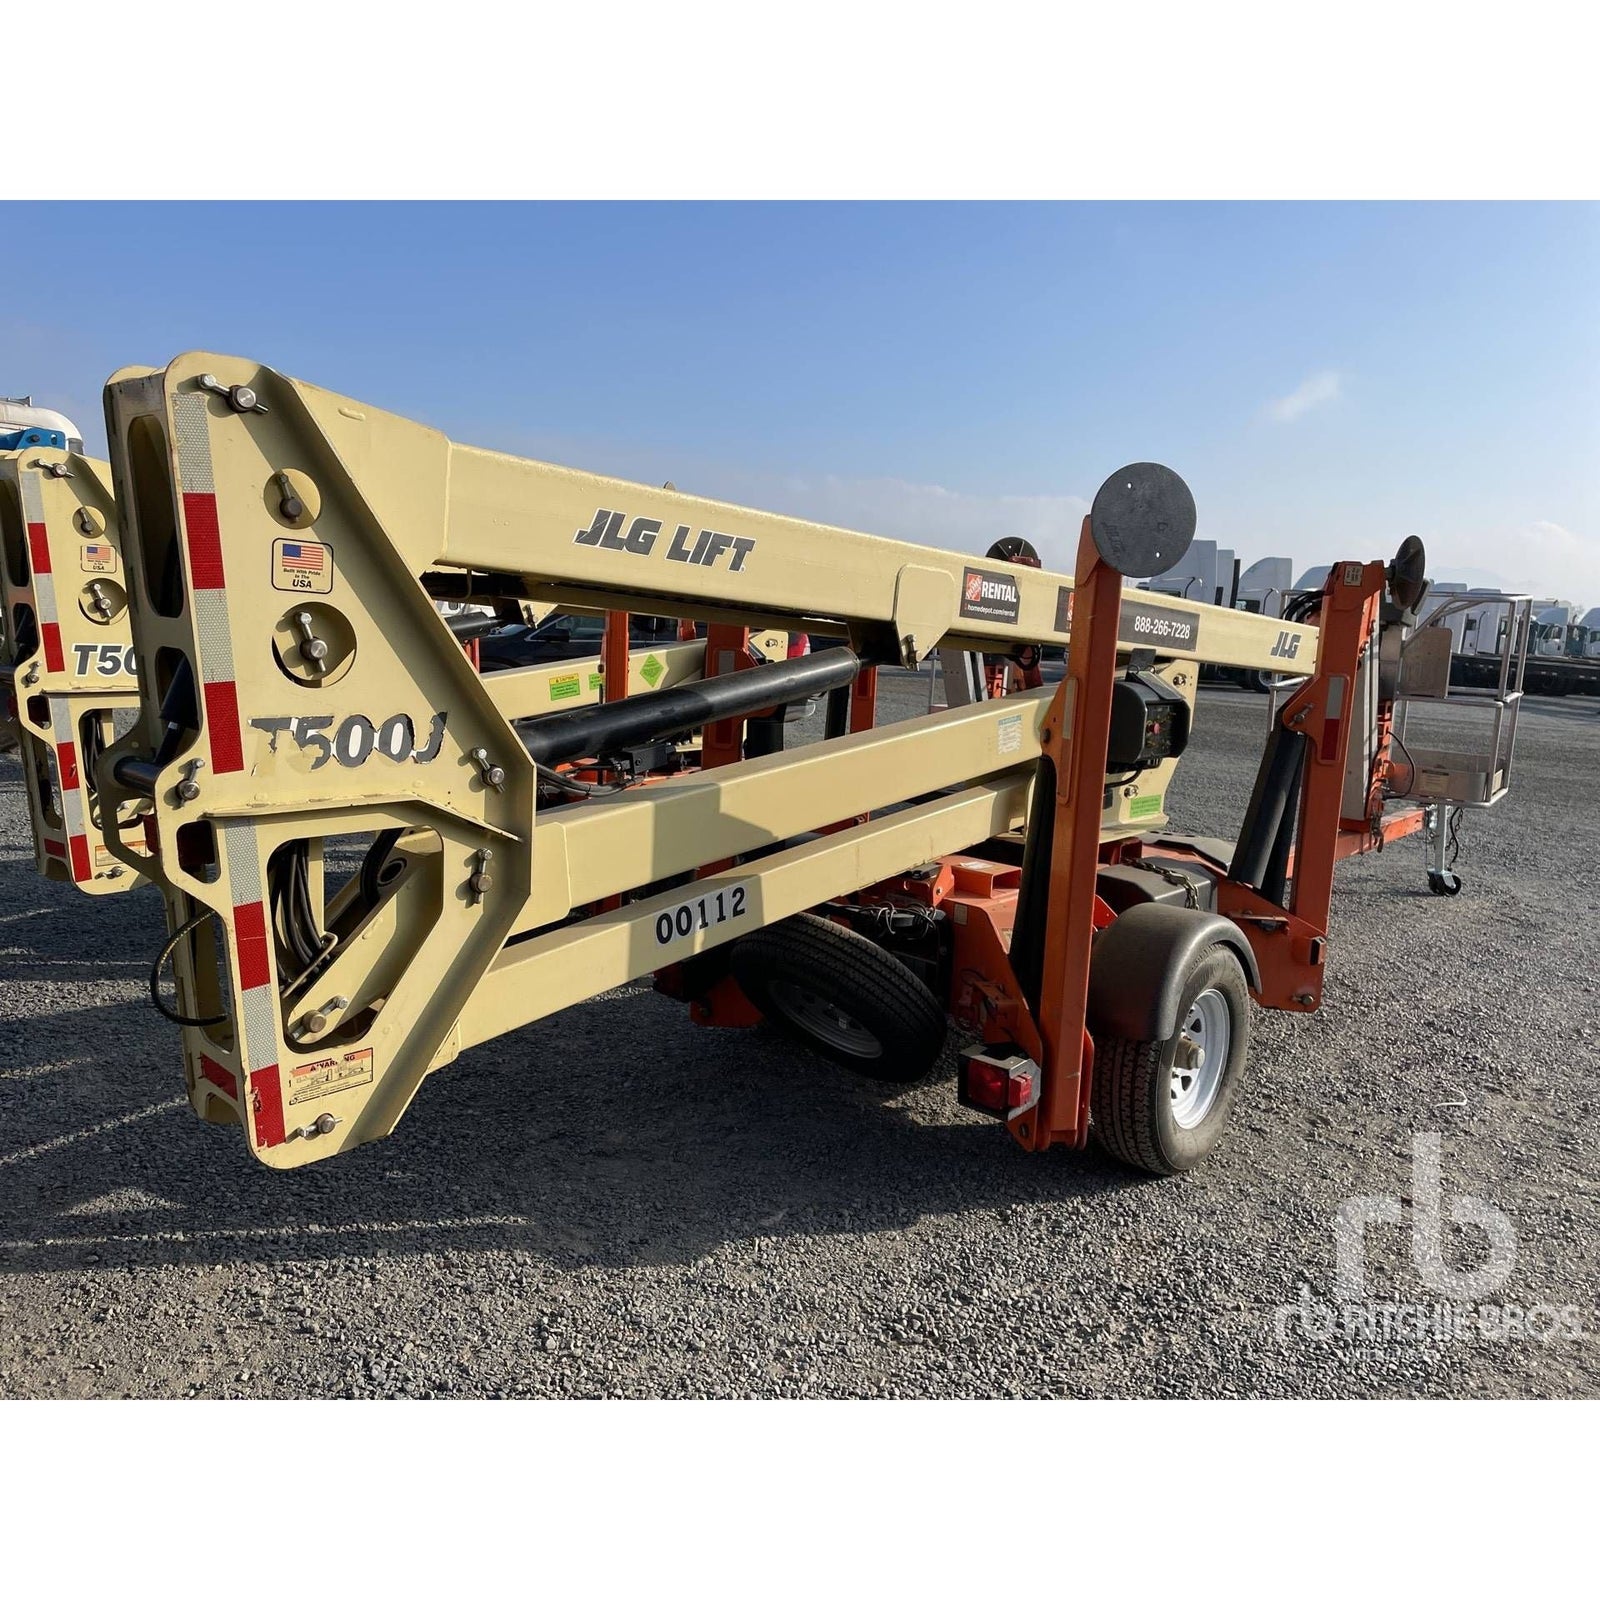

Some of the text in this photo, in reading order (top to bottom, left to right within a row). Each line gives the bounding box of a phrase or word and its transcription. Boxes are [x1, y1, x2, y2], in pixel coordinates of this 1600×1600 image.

[573, 508, 756, 572] JLG LIFT
[292, 578, 312, 589] USA
[981, 580, 1017, 603] RENTAL
[1134, 615, 1191, 640] 888-266-7228
[1270, 630, 1302, 660] JLG
[656, 886, 746, 945] 00112
